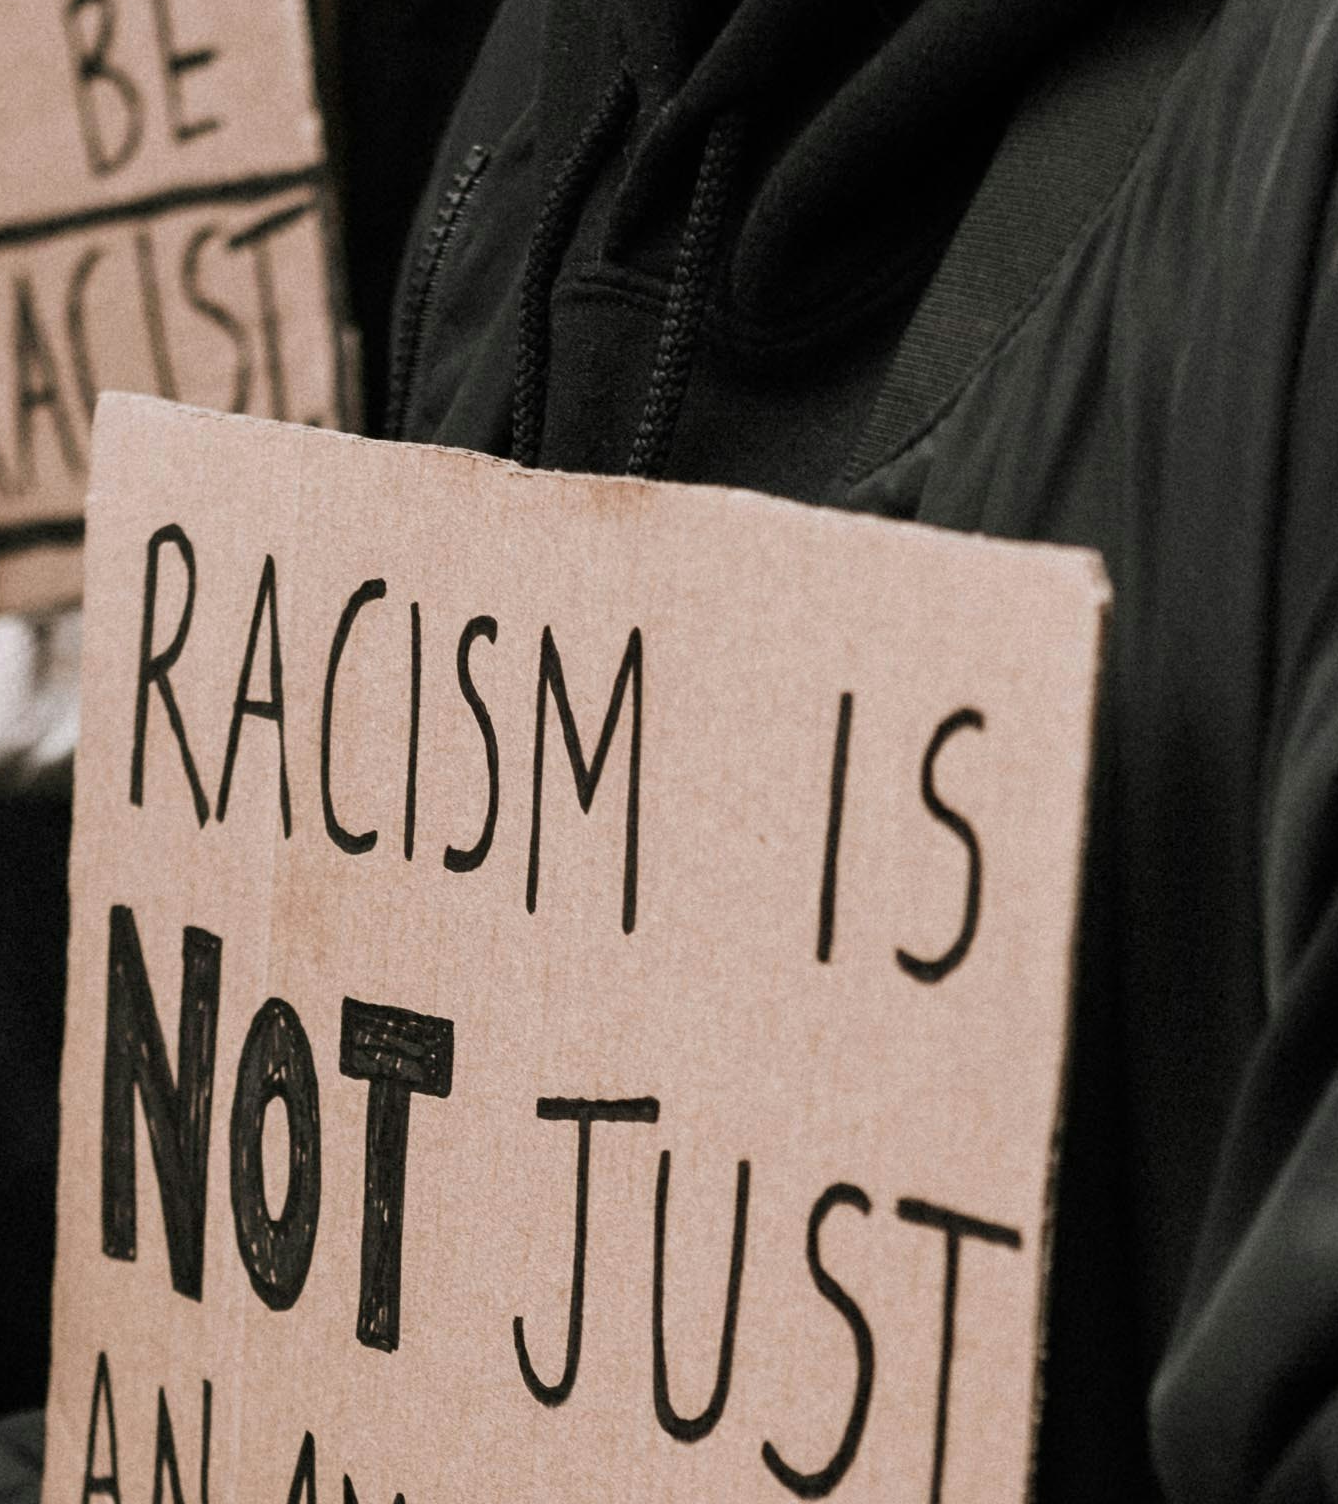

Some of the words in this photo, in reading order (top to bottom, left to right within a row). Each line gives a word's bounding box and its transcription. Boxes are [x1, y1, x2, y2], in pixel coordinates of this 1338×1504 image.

[131, 521, 646, 936] RACISM
[813, 688, 989, 986] IS
[99, 904, 456, 1354] NOT
